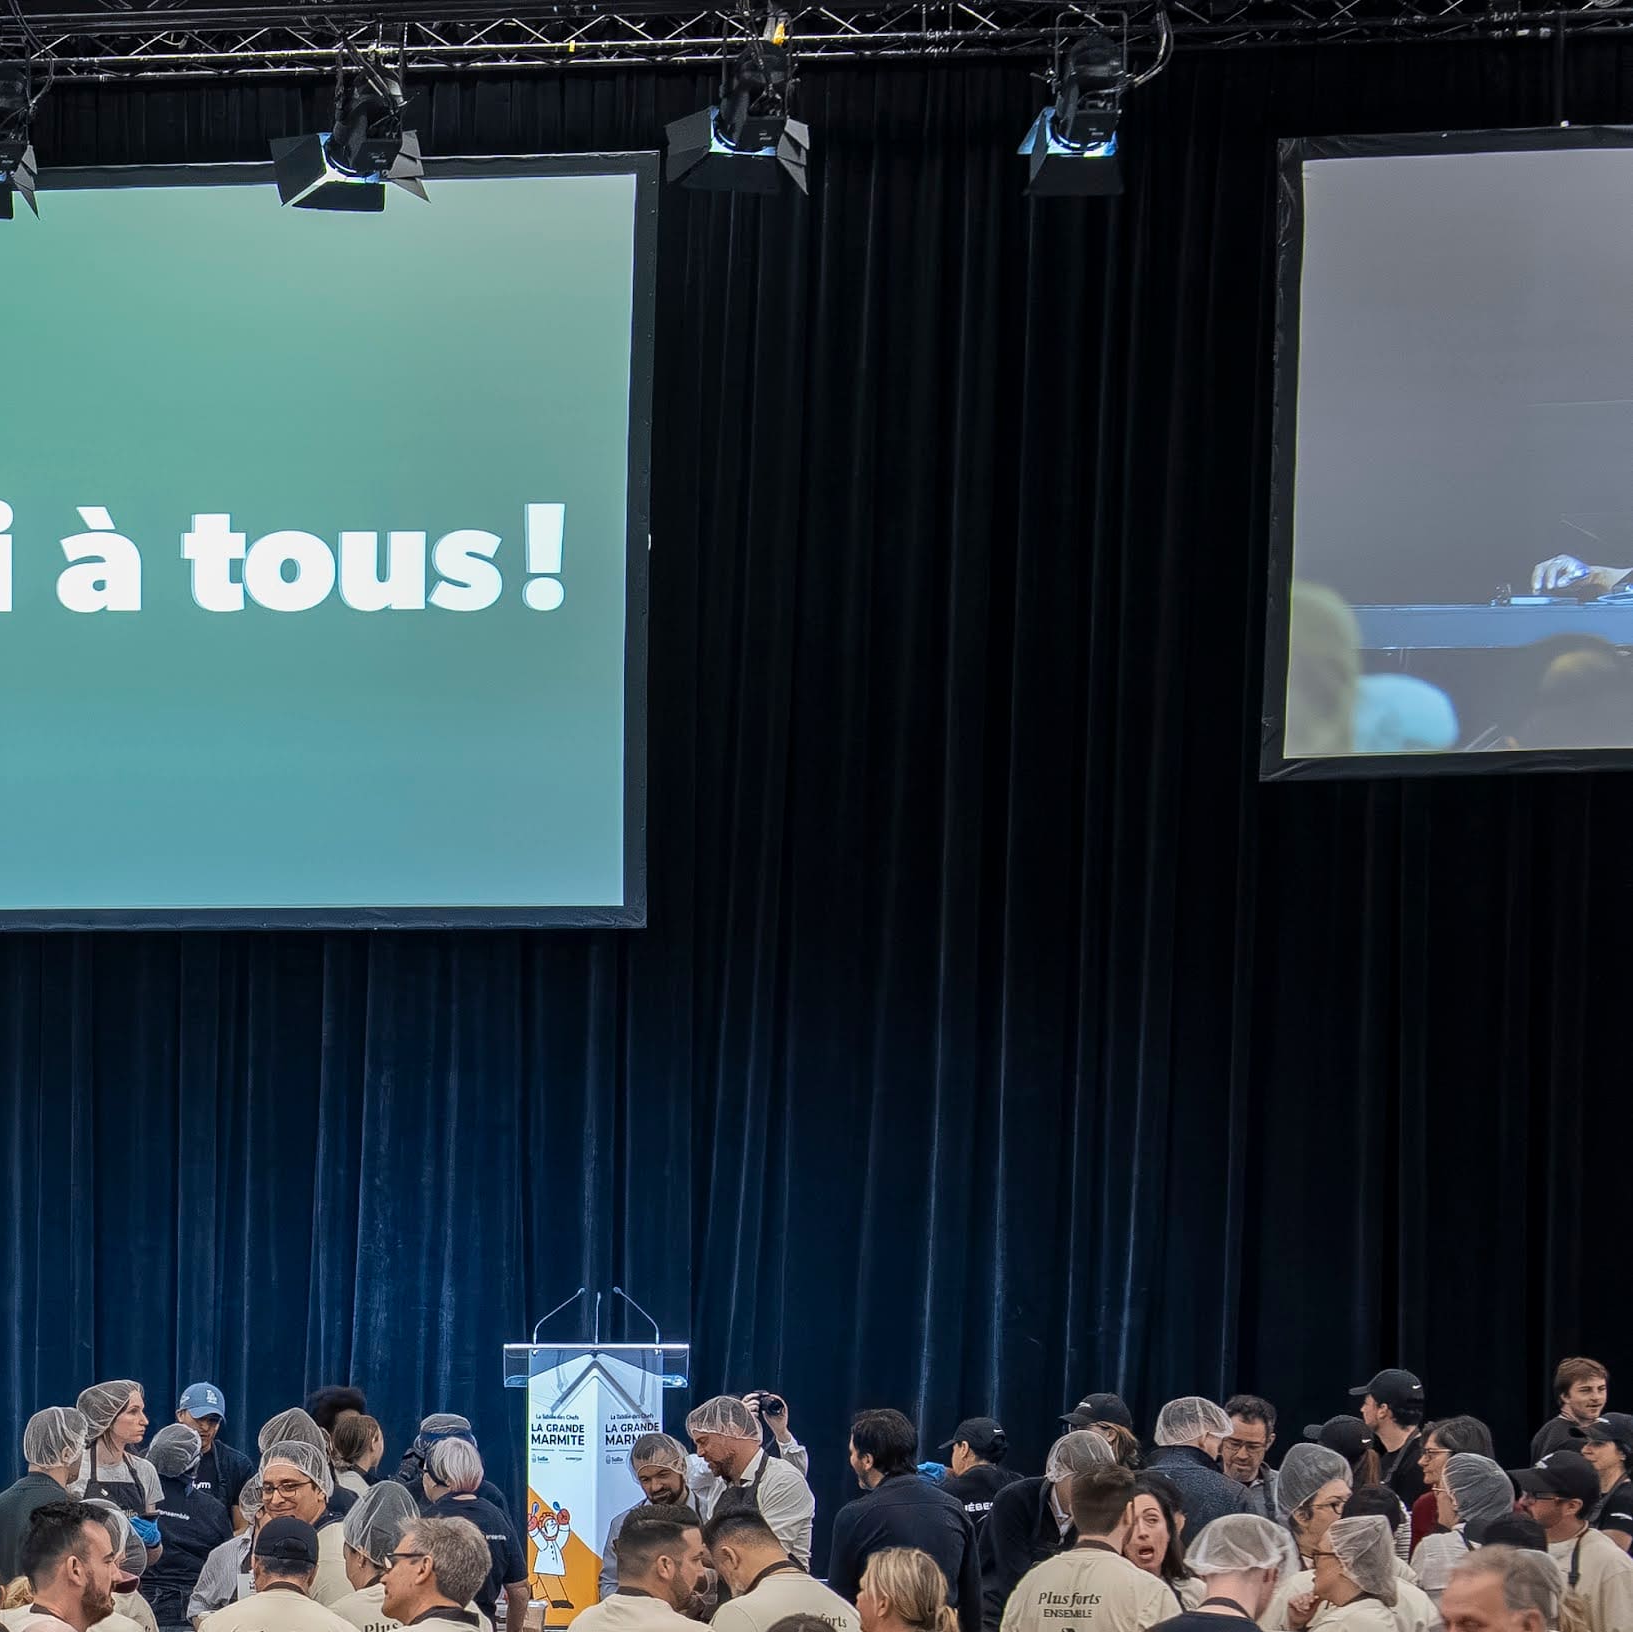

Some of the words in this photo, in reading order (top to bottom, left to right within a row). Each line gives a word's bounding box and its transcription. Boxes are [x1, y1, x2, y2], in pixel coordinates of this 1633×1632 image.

[56, 505, 141, 612] à
[531, 1424, 543, 1432] LA
[546, 1424, 585, 1433] GRANDE
[605, 1424, 618, 1433] LA
[620, 1422, 660, 1432] GRANDE
[531, 1434, 585, 1446] MARMITE
[1038, 1591, 1068, 1605] Plus
[1069, 1592, 1101, 1607] forts
